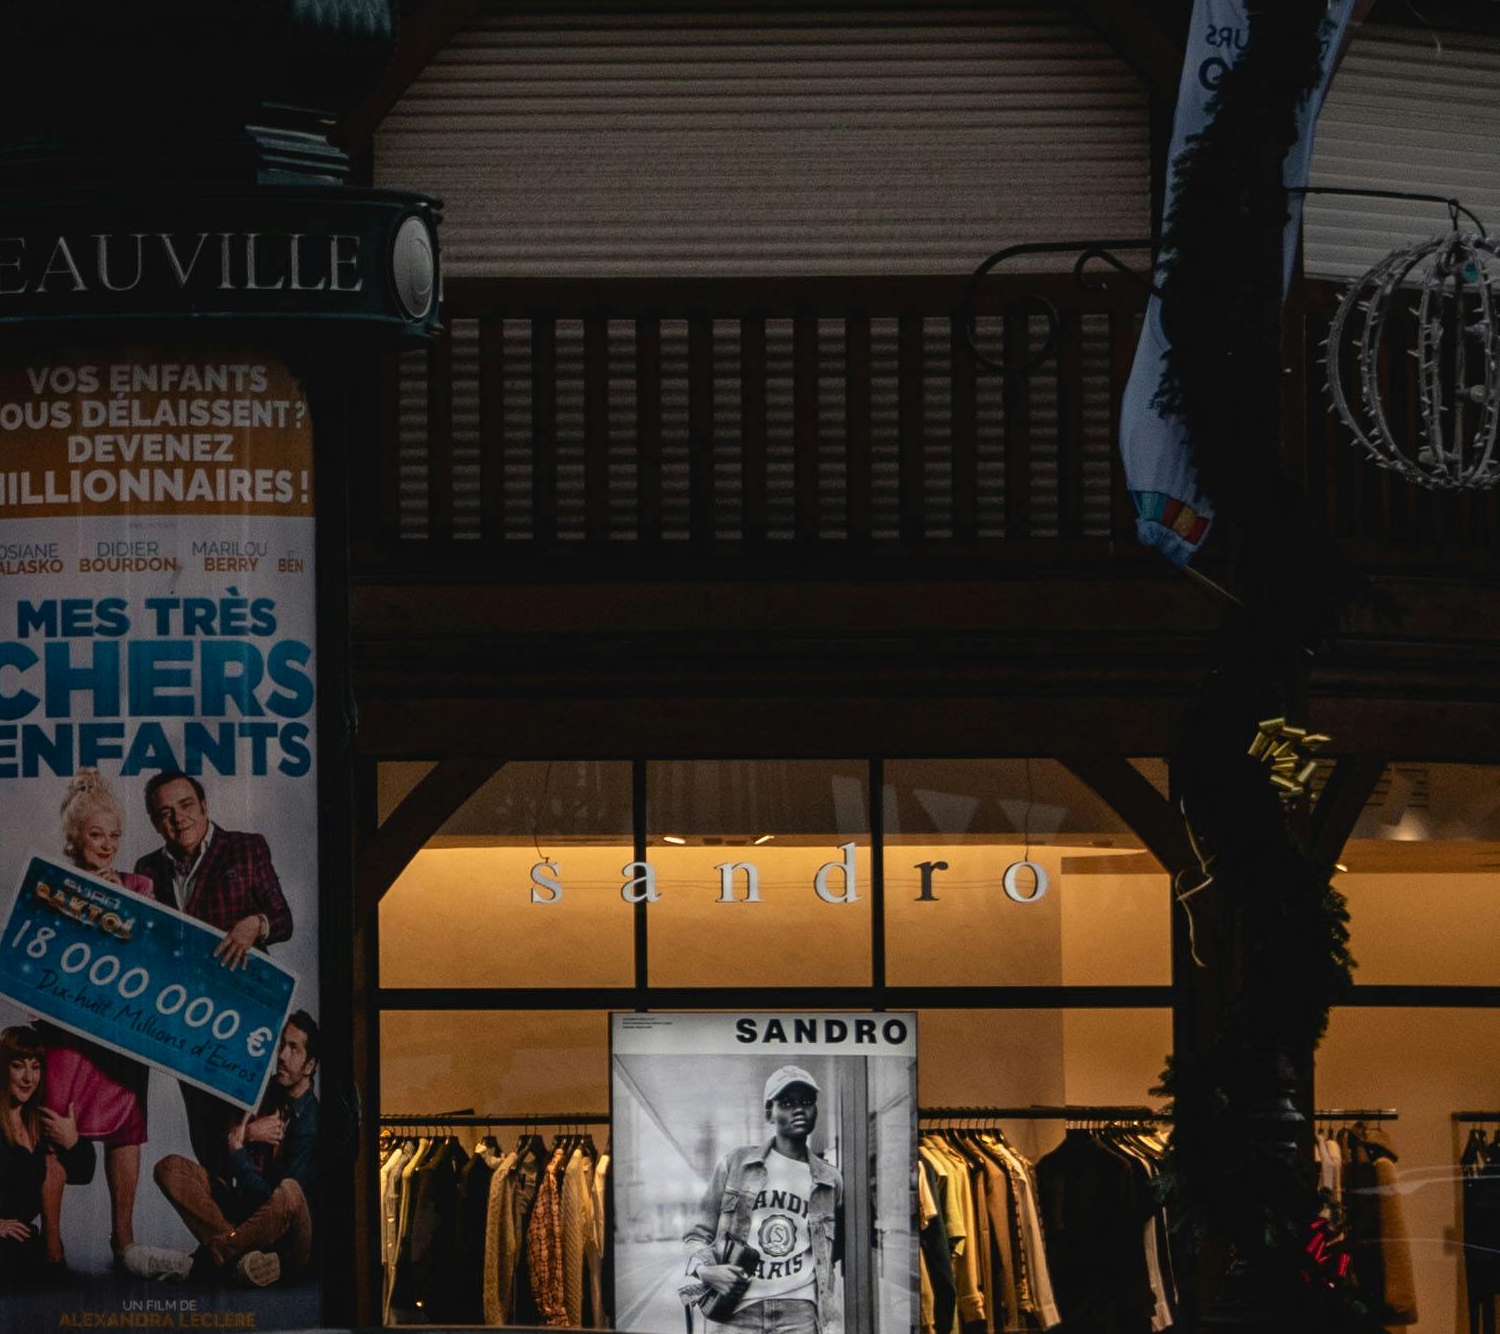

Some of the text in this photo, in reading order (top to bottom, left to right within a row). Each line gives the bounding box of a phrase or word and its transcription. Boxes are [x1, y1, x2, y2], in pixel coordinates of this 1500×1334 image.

[26, 363, 268, 395] VOS ENFANTS
[67, 433, 235, 464] DEVENEZ
[97, 540, 160, 558] DIDIER
[191, 539, 268, 557] MARILOU
[79, 557, 178, 573] BOURDON
[204, 556, 260, 573] BERRY
[278, 557, 305, 573] BEN
[17, 585, 277, 639] MES TRÈS
[530, 842, 1049, 904] sandro
[10, 918, 57, 959] 18
[59, 940, 151, 1000] 000
[154, 982, 242, 1041] 000
[735, 1017, 908, 1045] SANDRO
[753, 1253, 804, 1280] ARIS
[122, 1299, 197, 1312] UN FILM DE
[58, 1311, 174, 1329] ALEXANDRA
